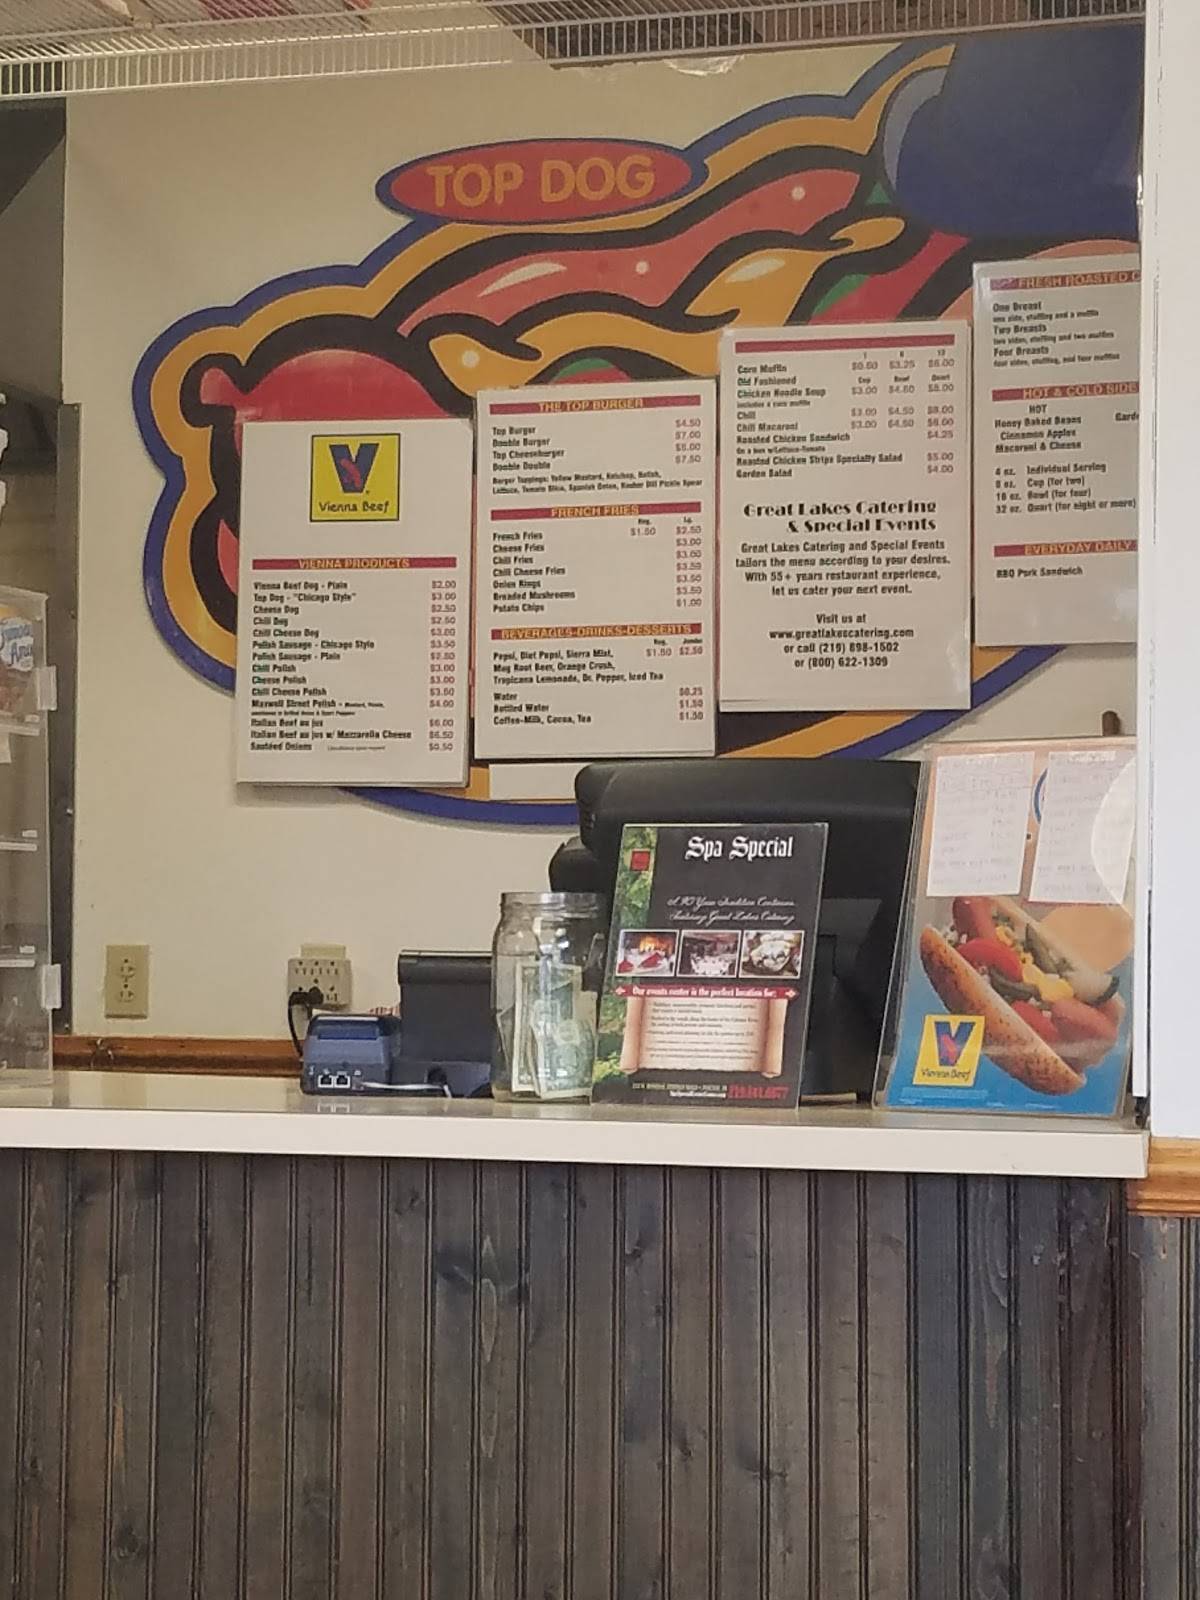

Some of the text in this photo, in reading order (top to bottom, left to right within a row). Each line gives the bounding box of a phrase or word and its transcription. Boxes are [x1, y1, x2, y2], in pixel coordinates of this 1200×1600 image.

[426, 155, 655, 208] TOP DOG
[993, 302, 1041, 312] One Breast
[994, 348, 1012, 356] Four
[760, 365, 787, 373] Muffin
[737, 376, 796, 386] Old Fashioned
[738, 388, 826, 398] Chicken Noodle Soup
[1023, 389, 1049, 399] HOT
[1067, 385, 1102, 397] COLD
[539, 399, 643, 412] THE TOP BURGER
[1029, 405, 1047, 413] HOT
[493, 427, 506, 436] Top
[509, 426, 536, 436] Burger
[493, 439, 520, 447] Double
[523, 438, 550, 447] Burger
[737, 433, 850, 443] Roasted Chicken Sandwich
[493, 450, 564, 459] Top Cheeseburger
[329, 443, 379, 493] V
[493, 463, 520, 471] Double
[523, 462, 550, 470] Double
[319, 501, 389, 513] Vienna Beef
[552, 505, 640, 517] FRENCH FRIES
[744, 500, 936, 516] Great Lakes Catering
[787, 518, 936, 533] & Special Events
[493, 532, 542, 541] French Fries
[493, 545, 521, 553] Cheese
[525, 544, 544, 552] Fries
[741, 539, 944, 553] Great Lakes Catering and Special Events
[1025, 542, 1131, 555] EVERYDAY DAILY
[299, 558, 410, 569] VIENNA PRODUCTS
[736, 558, 767, 567] tailors
[770, 557, 786, 566] the
[819, 556, 868, 567] according
[872, 556, 881, 565] to
[886, 556, 907, 566] your
[910, 554, 950, 564] desires.
[745, 569, 941, 583] With 55+ years restaurant experience,
[253, 582, 280, 590] Vienna
[284, 581, 301, 589] Beef
[304, 581, 319, 591] Dog
[328, 581, 347, 589] Plain
[493, 580, 541, 589] Onion Rings
[494, 590, 575, 600] Breaded Mushrooms
[772, 585, 912, 596] let us cater your next event.
[254, 594, 267, 603] Top
[270, 593, 284, 603] Dog
[294, 593, 329, 602] "Chicago
[333, 592, 356, 601] Style"
[285, 605, 299, 615] Dog
[493, 604, 519, 613] Potato
[522, 603, 544, 612] Chips
[253, 617, 270, 625] Chili
[274, 617, 288, 626] Dog
[816, 614, 866, 624] Visit us at
[769, 628, 913, 640] www.greatlakescatering.com
[784, 642, 899, 654] or call (219) 898-1502
[795, 656, 888, 669] or (800) 622-1309
[252, 676, 280, 684] Cheese
[283, 676, 306, 684] Polish
[494, 703, 549, 712] Bottled Water
[685, 836, 793, 862] Spa Special
